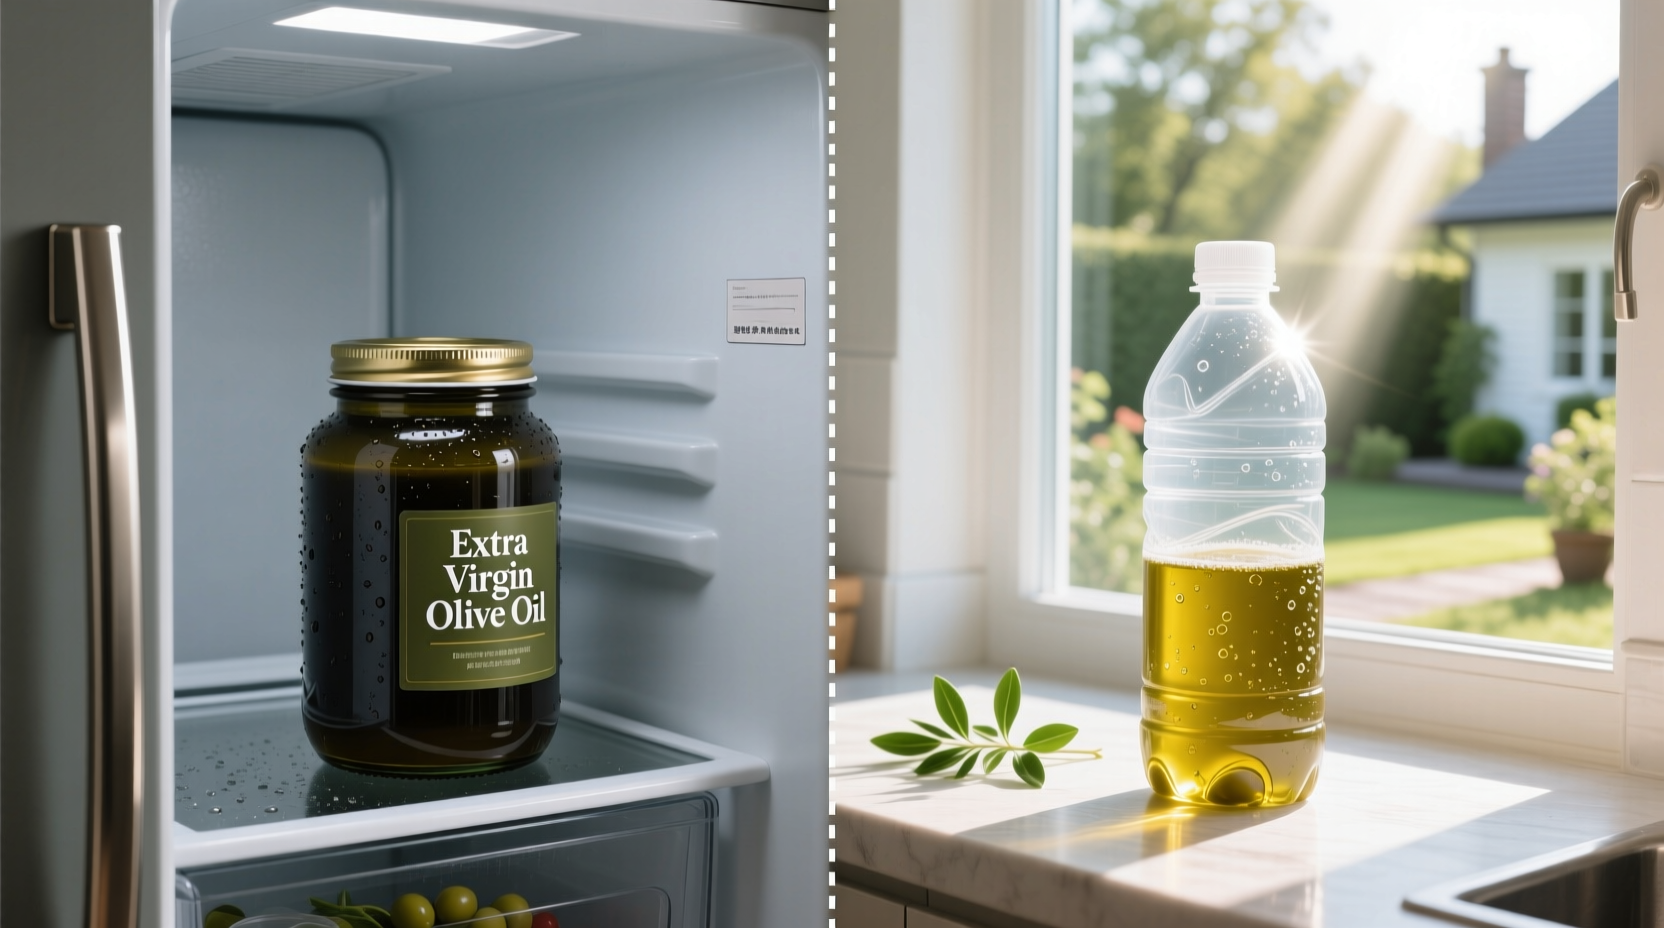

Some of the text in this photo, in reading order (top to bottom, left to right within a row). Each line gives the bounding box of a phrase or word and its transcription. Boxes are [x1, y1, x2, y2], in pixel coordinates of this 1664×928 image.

[449, 528, 529, 558] Extra
[442, 560, 535, 601] Virgin
[425, 590, 546, 631] Olive Oil
